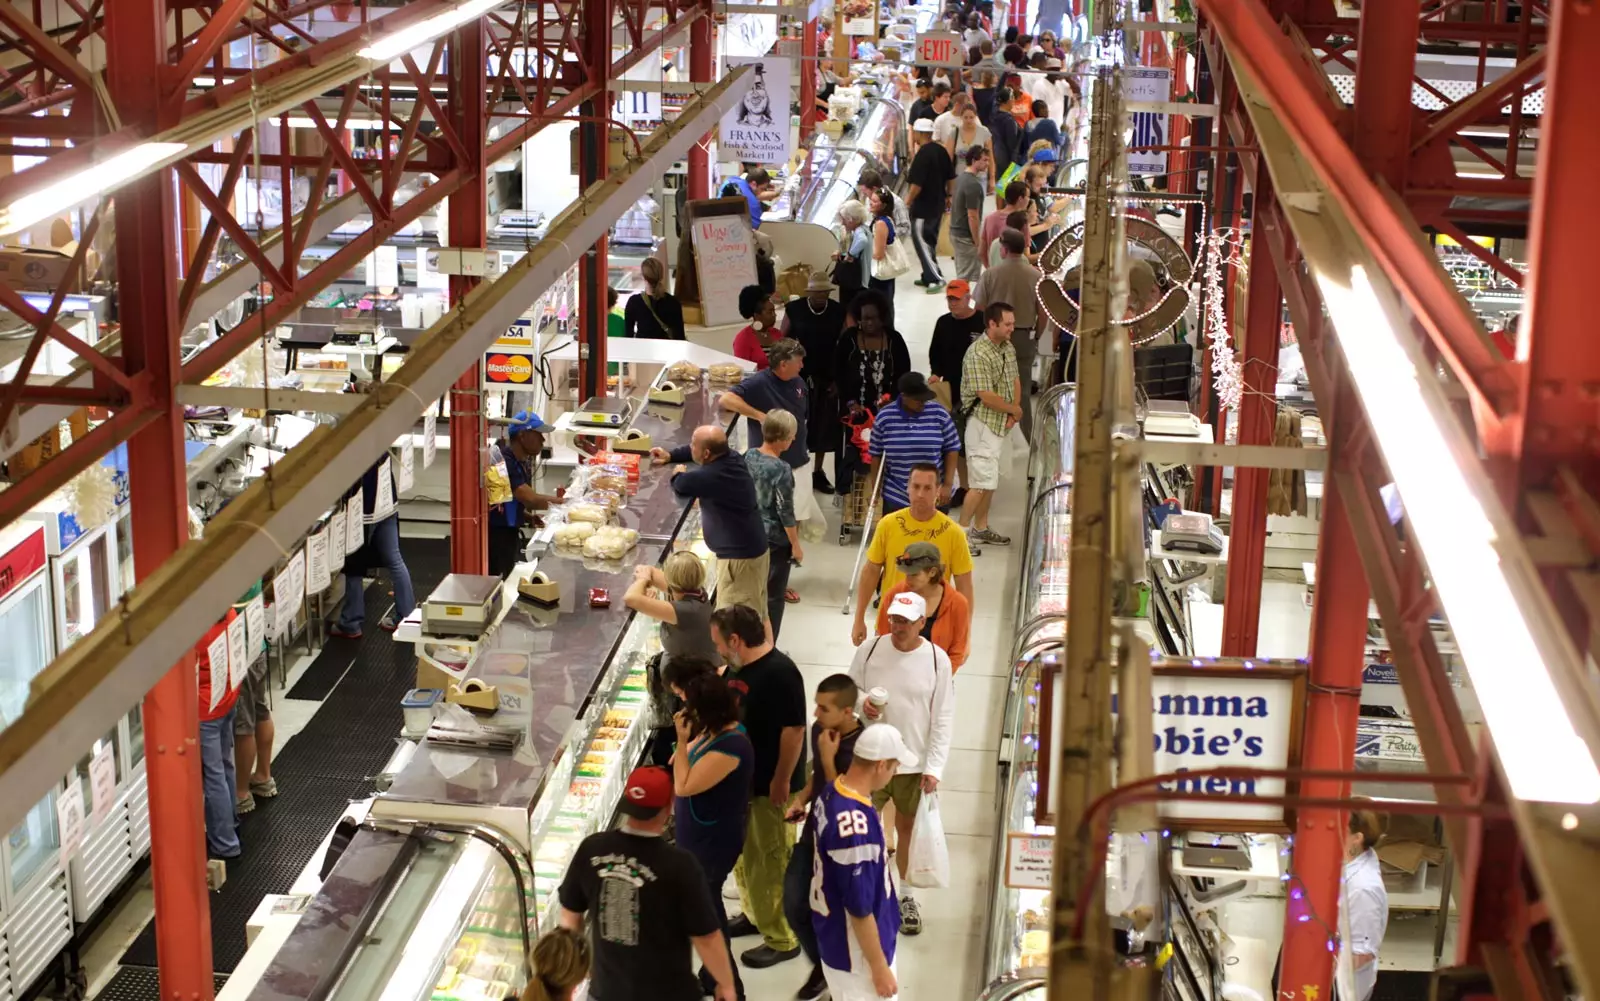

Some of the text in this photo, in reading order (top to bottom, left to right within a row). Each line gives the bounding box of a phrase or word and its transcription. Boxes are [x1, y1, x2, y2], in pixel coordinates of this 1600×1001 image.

[924, 39, 952, 62] EXIT
[730, 130, 782, 141] FRANK'S
[724, 141, 740, 149] Fish
[752, 143, 784, 151] Seafood
[736, 150, 765, 159] Market
[503, 326, 524, 337] ISA
[487, 363, 531, 373] MasterCard
[1152, 694, 1268, 718] mma
[1384, 735, 1418, 758] Purity
[836, 809, 869, 838] 28
